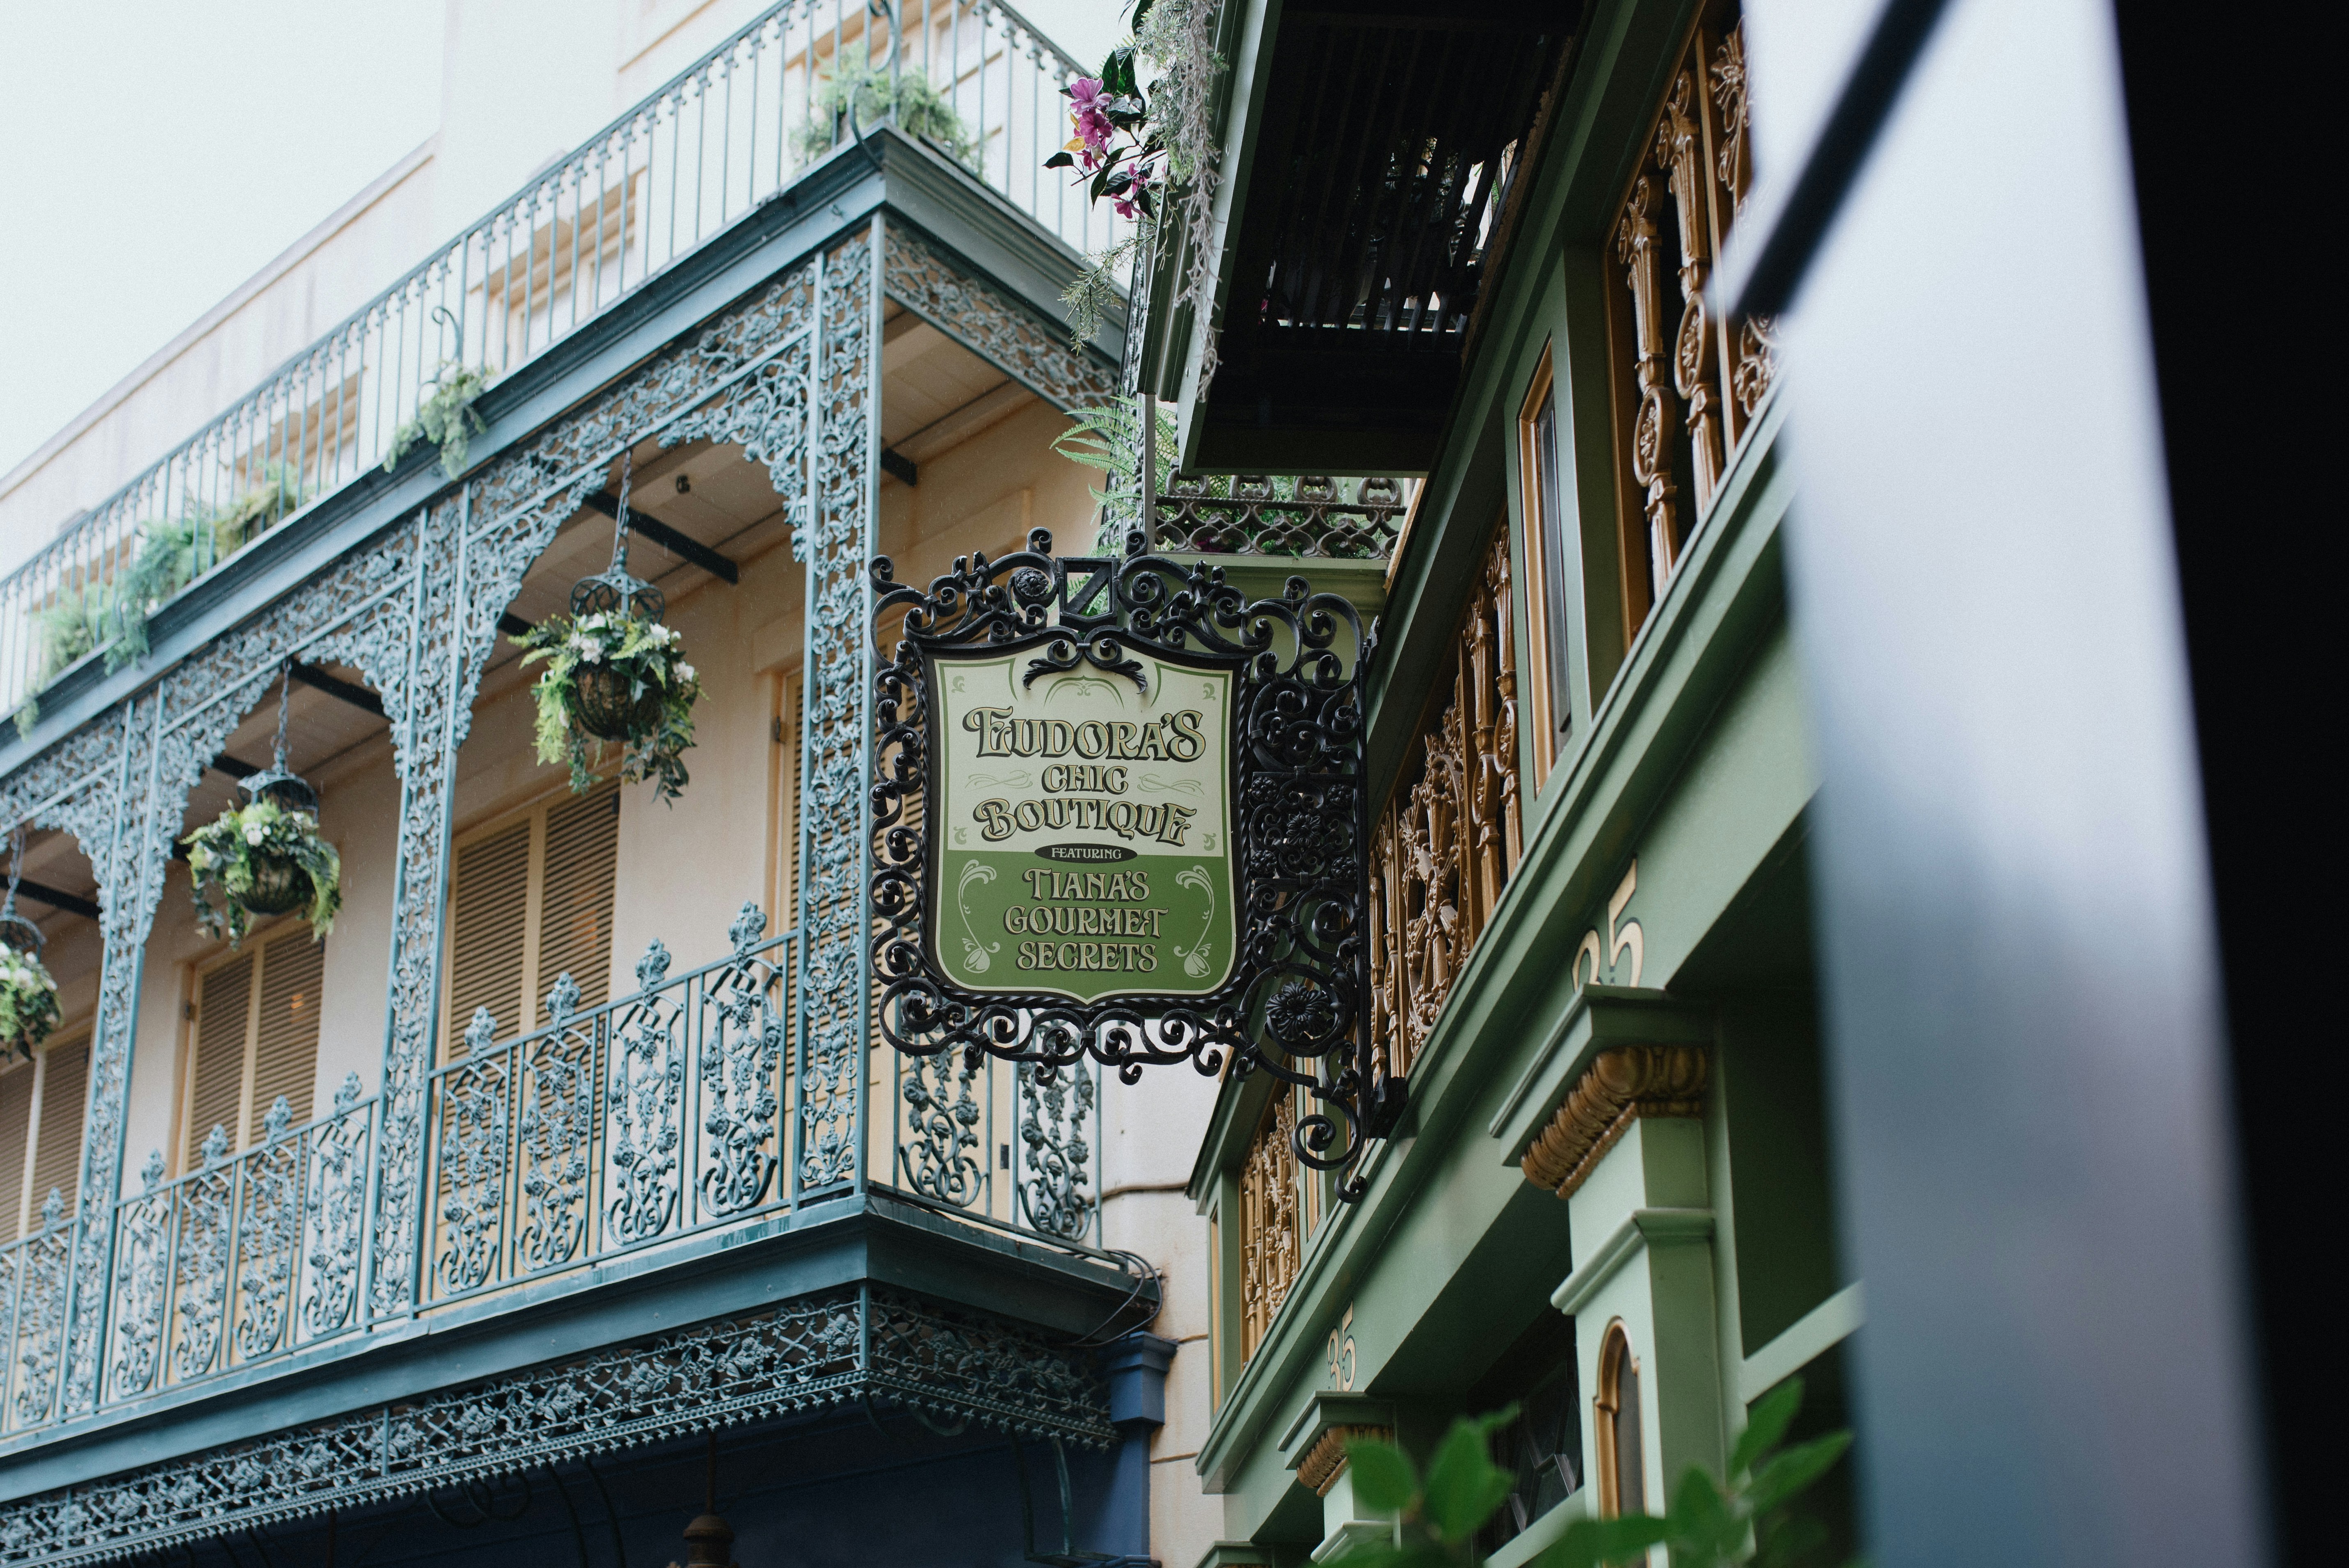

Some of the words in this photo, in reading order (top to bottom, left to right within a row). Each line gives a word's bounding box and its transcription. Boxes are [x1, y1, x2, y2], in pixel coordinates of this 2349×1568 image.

[963, 706, 1206, 762] EUDORA'S
[1042, 764, 1128, 795] CHIC
[973, 798, 1197, 846] BOUTIQUE
[1051, 848, 1122, 859] FEATURING
[1022, 868, 1150, 901] TIANA'S
[1003, 906, 1169, 939] GOURMET
[1016, 941, 1158, 972] SECRETS
[1327, 1300, 1356, 1392] 35
